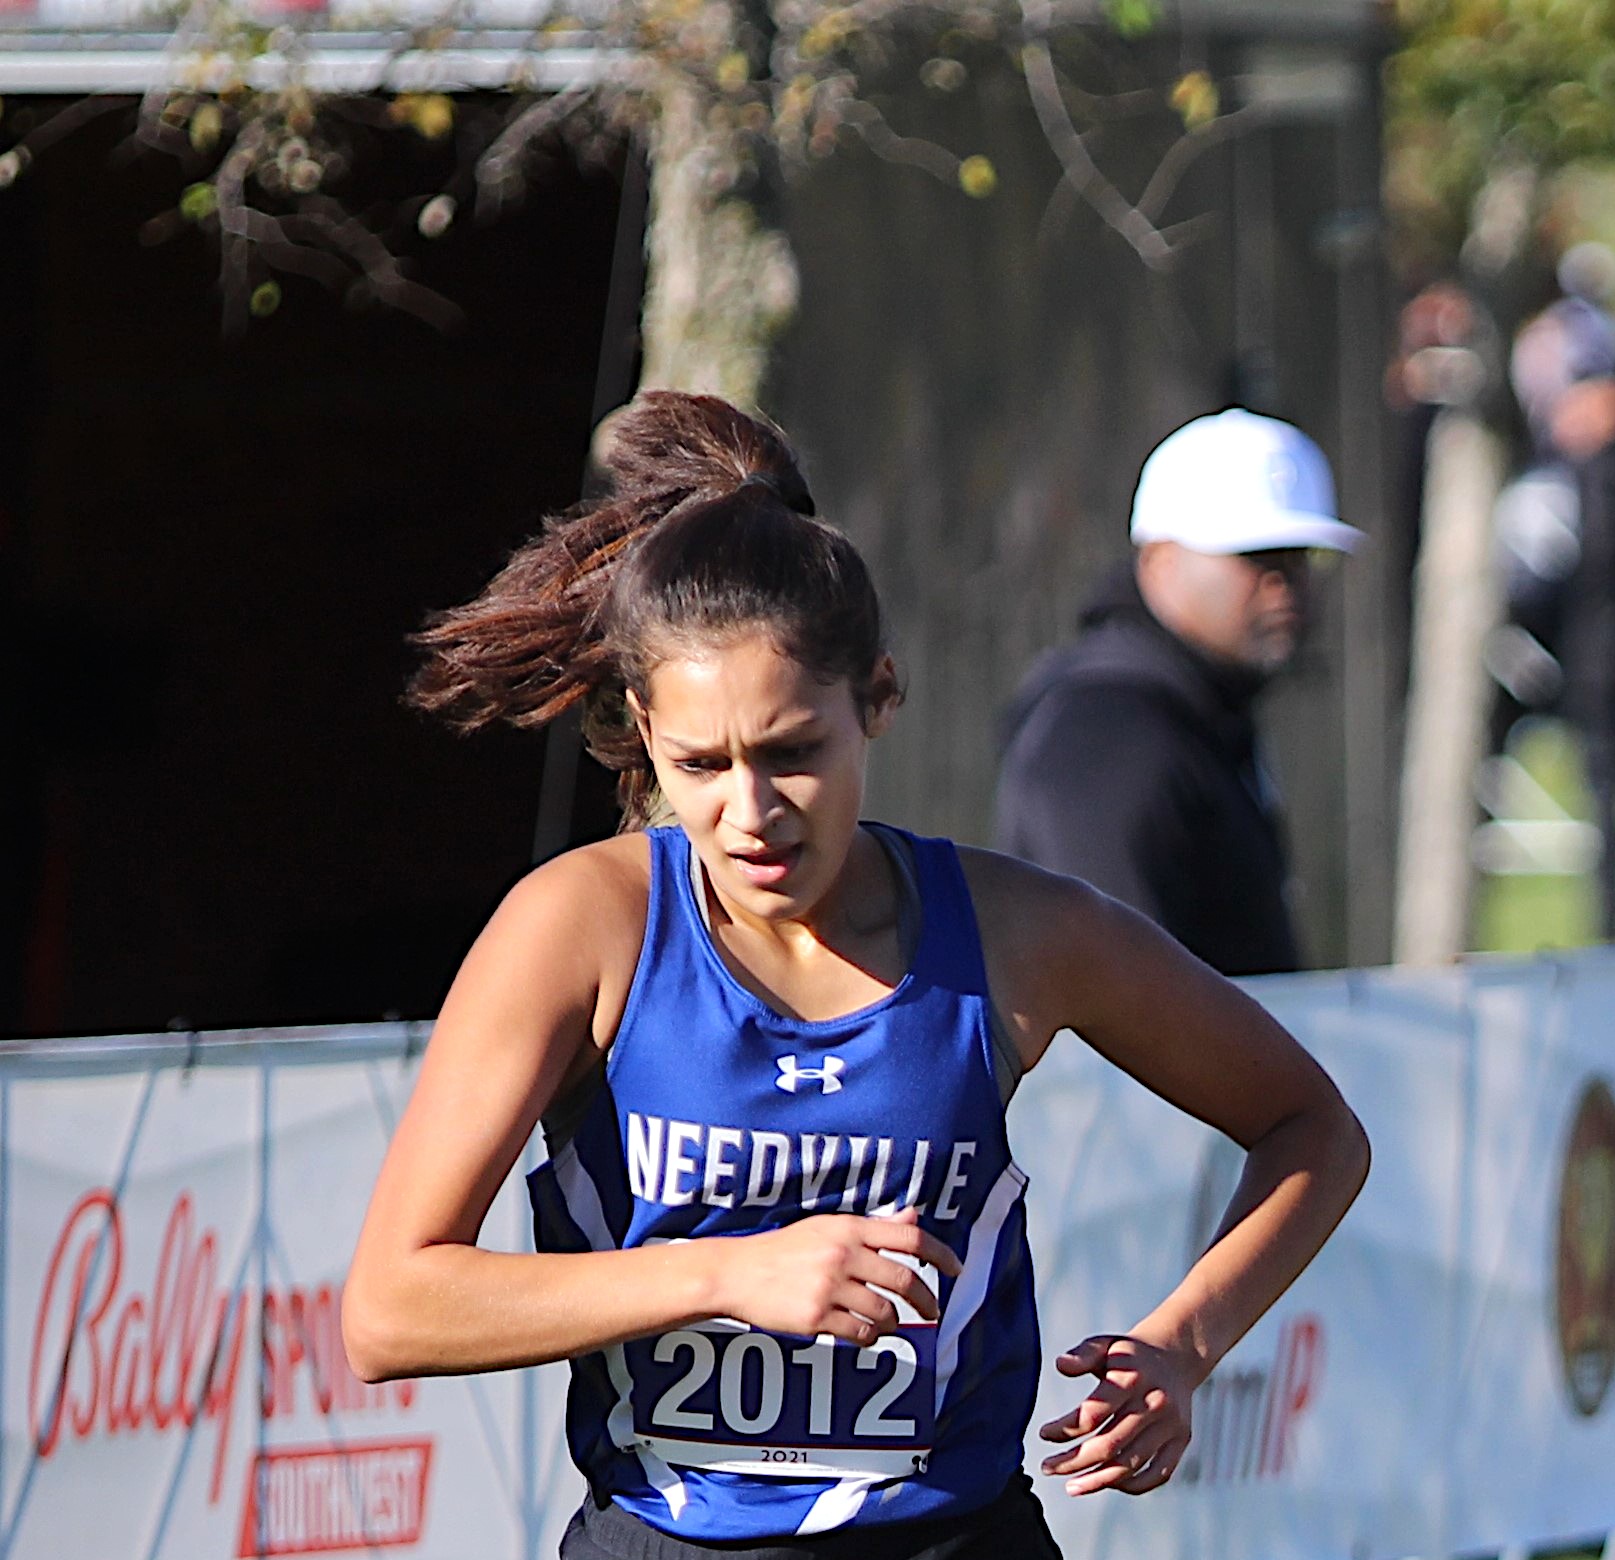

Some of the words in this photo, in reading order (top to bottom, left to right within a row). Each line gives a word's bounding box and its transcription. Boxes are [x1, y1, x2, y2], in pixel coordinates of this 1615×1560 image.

[627, 1112, 976, 1220] NEEDVILLE
[28, 1187, 250, 1503] Bally
[651, 1331, 918, 1438] 2012
[760, 1449, 808, 1464] 2021
